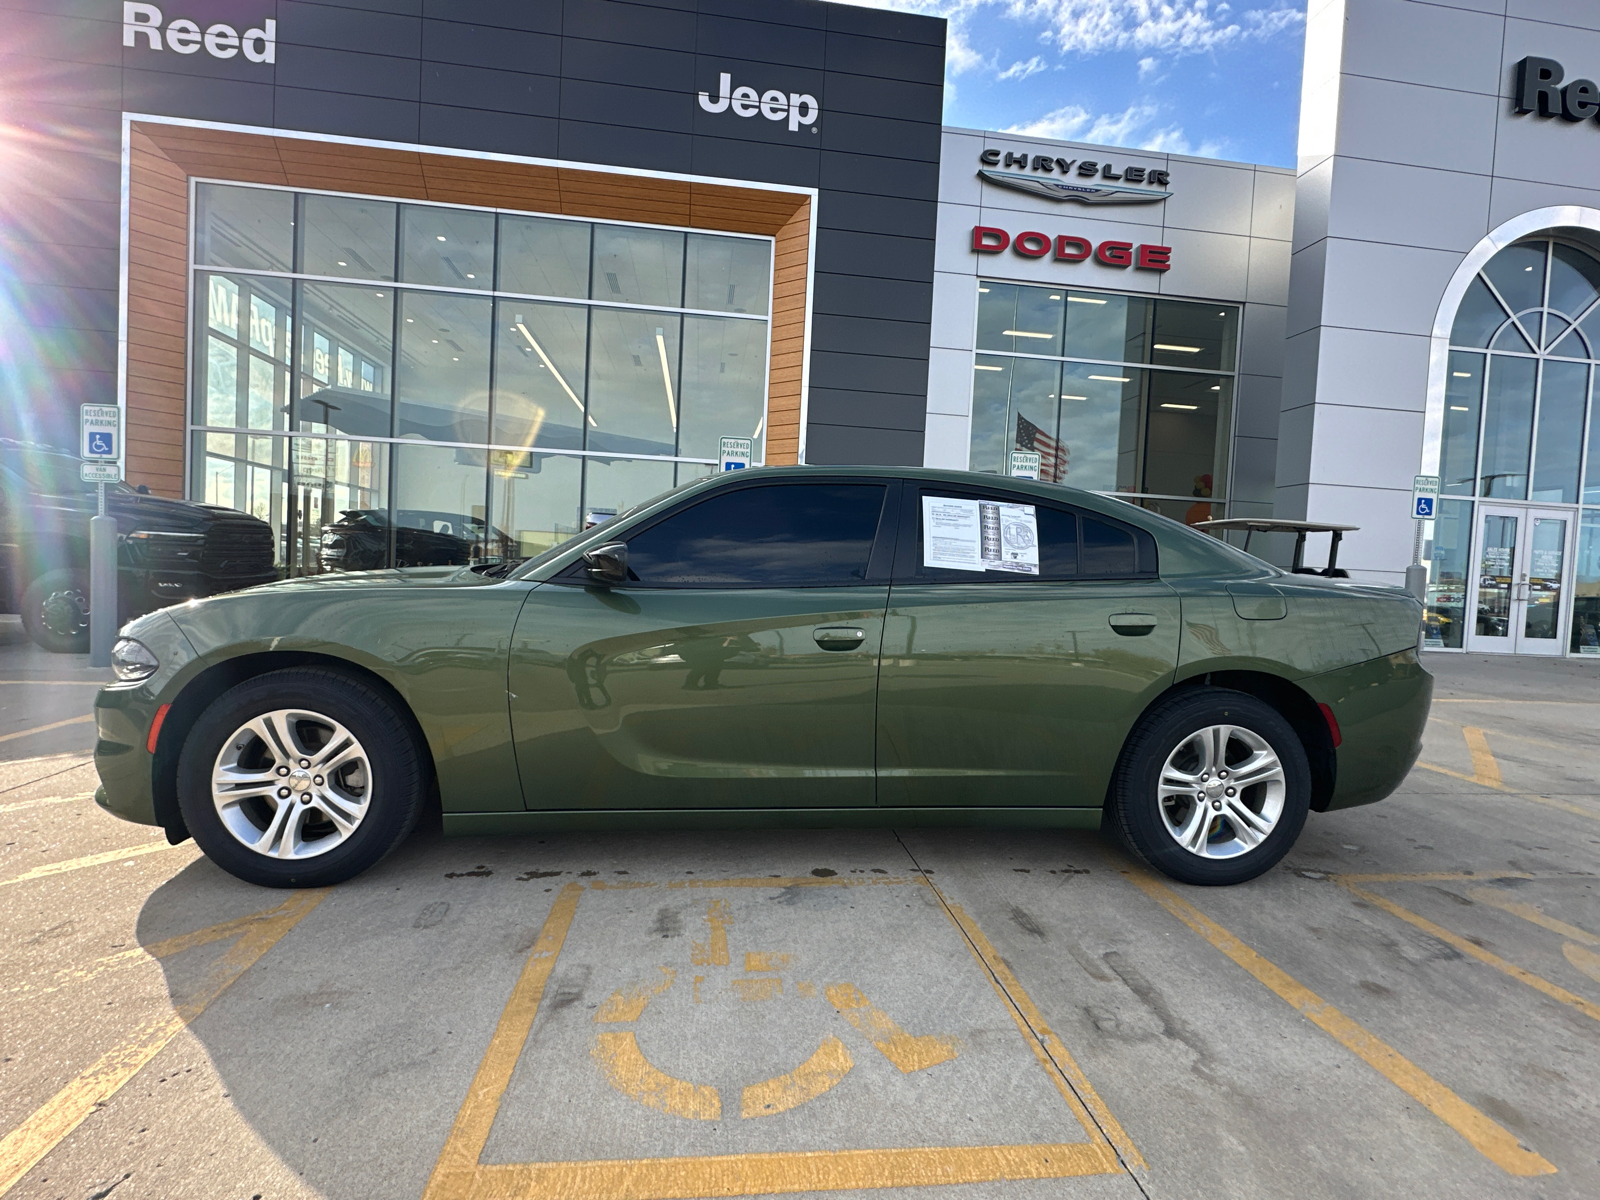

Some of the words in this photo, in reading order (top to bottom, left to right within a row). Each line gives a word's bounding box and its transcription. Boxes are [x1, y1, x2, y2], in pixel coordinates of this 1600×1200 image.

[122, 0, 277, 64] Reed
[1515, 55, 1600, 122] Re
[698, 72, 819, 132] Jeep
[980, 149, 1171, 185] CHRYSLER
[972, 225, 1172, 272] DODGE
[84, 408, 117, 418] RESERVED
[84, 419, 117, 428] PARKING
[722, 441, 750, 449] RESERVED
[721, 449, 750, 458] PARKING
[1012, 455, 1038, 464] RESERVED
[1012, 463, 1038, 472] PARKING
[1415, 486, 1437, 494] PARKING
